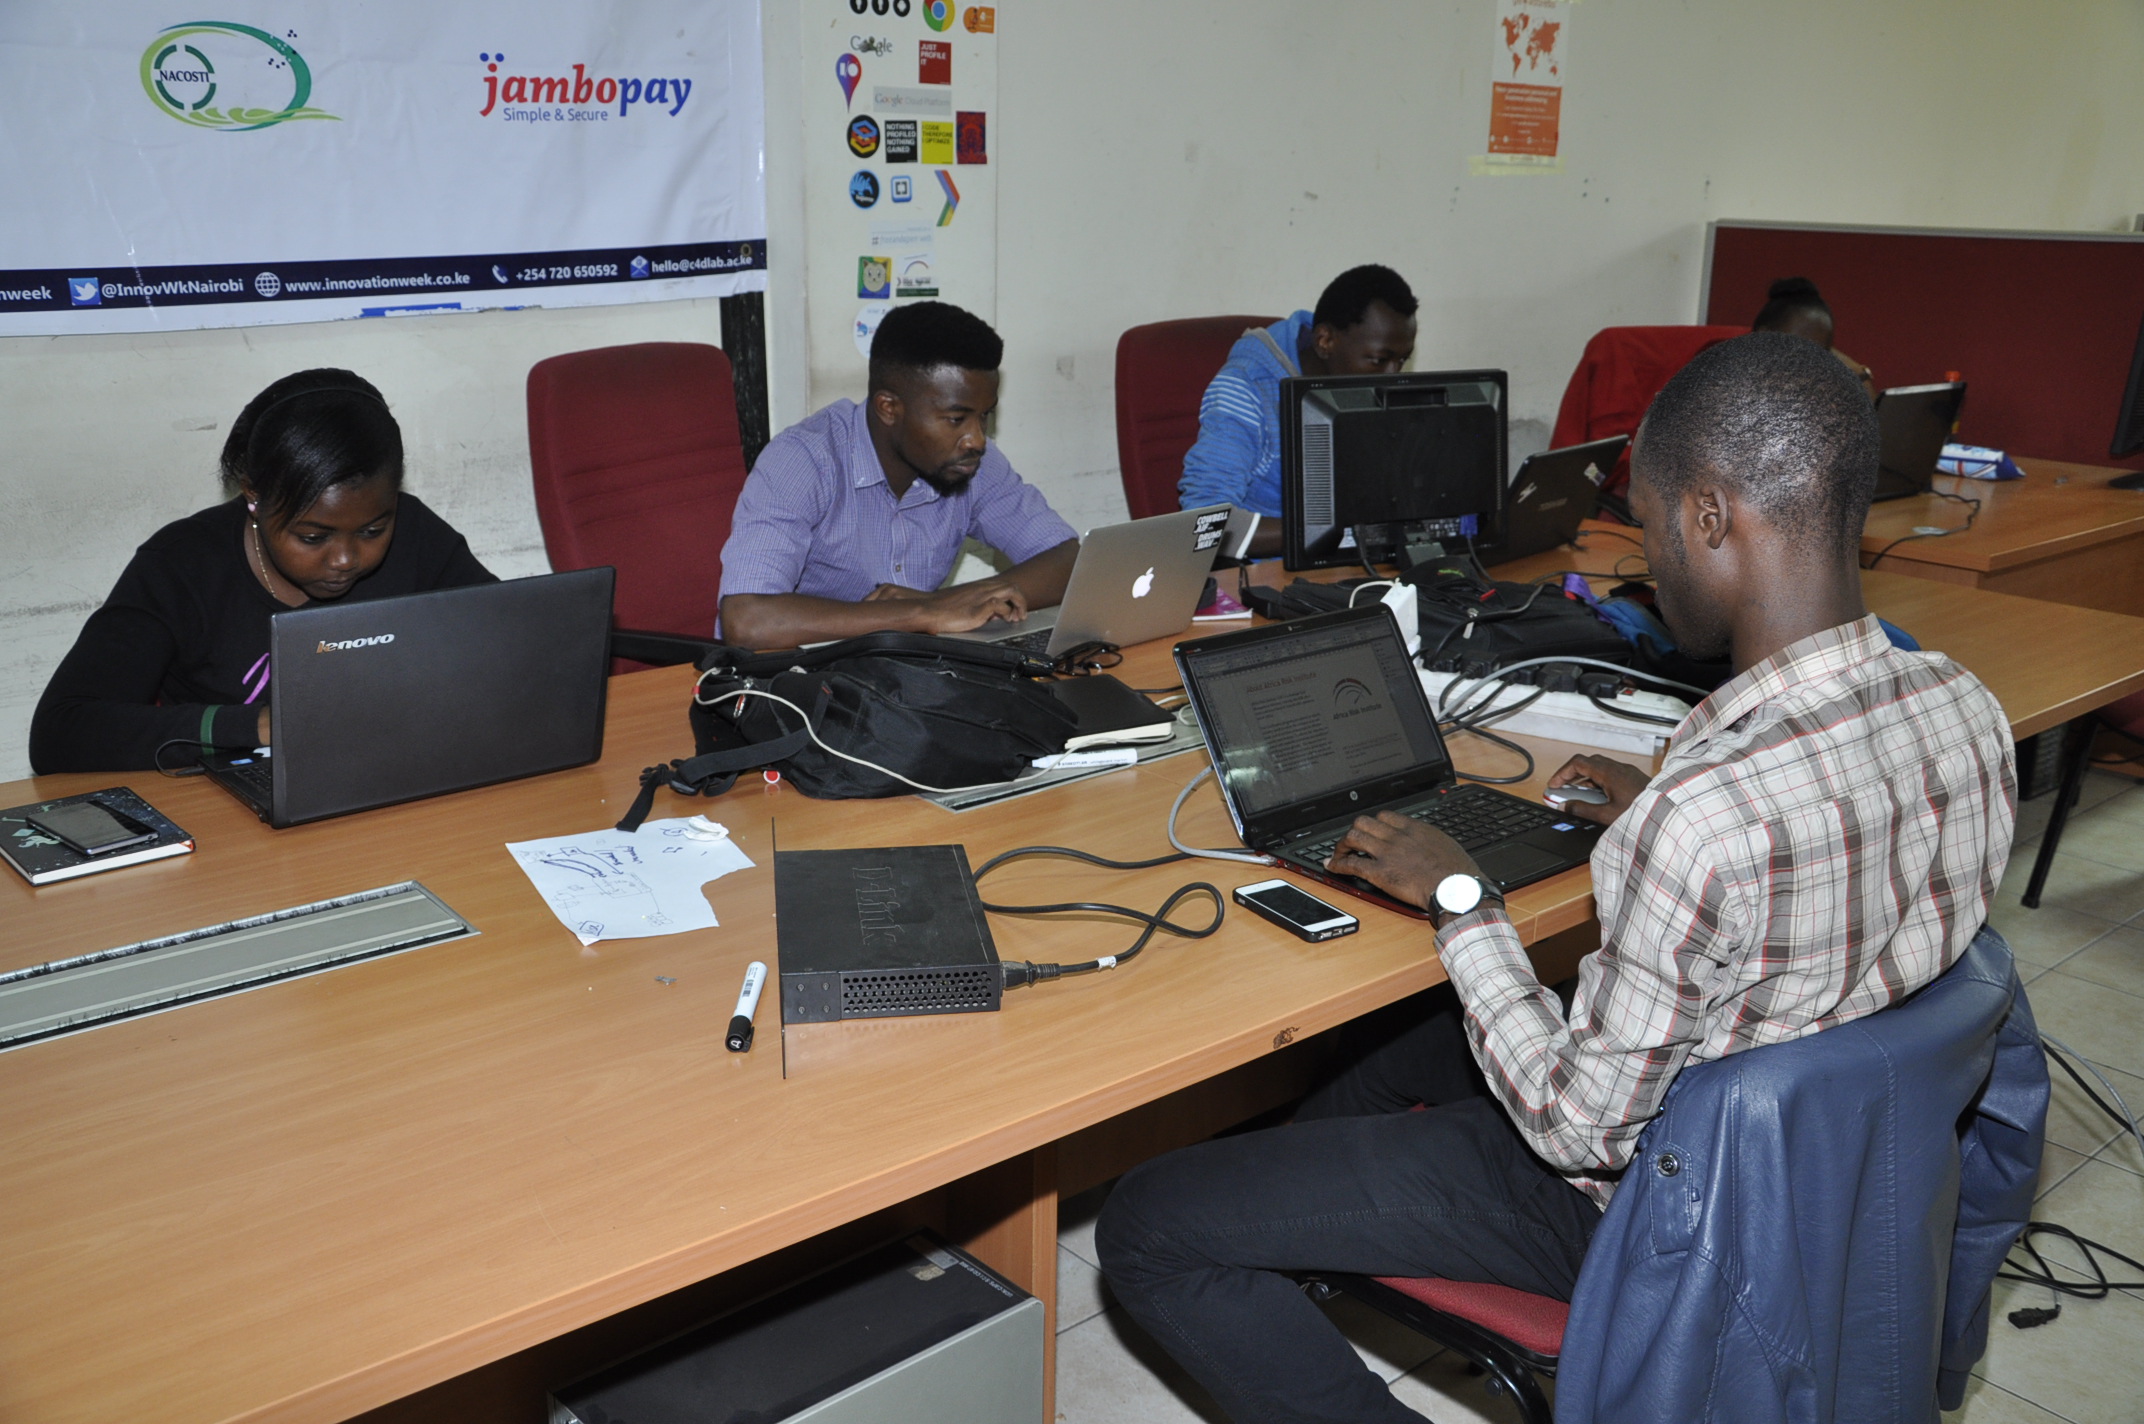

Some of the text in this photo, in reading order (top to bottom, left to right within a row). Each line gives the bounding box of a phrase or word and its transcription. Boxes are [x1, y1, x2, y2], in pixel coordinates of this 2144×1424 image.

[850, 35, 893, 57] Ggle
[921, 43, 937, 51] JUST
[921, 51, 946, 60] PROFILE
[159, 70, 210, 83] NACOSTI
[479, 62, 693, 118] jambopay
[503, 107, 608, 124] Simple & Secure
[886, 138, 915, 146] NOTHING
[515, 264, 618, 280] +254 720 650592
[651, 254, 753, 274] hello@c4dlab.ac.ke
[101, 278, 244, 299] @InnovWkNairobi
[285, 272, 470, 292] www.innovationweek.co.ke
[1197, 511, 1229, 525] COWBELL
[1198, 529, 1223, 542] DRUMS
[316, 633, 395, 654] lenovo
